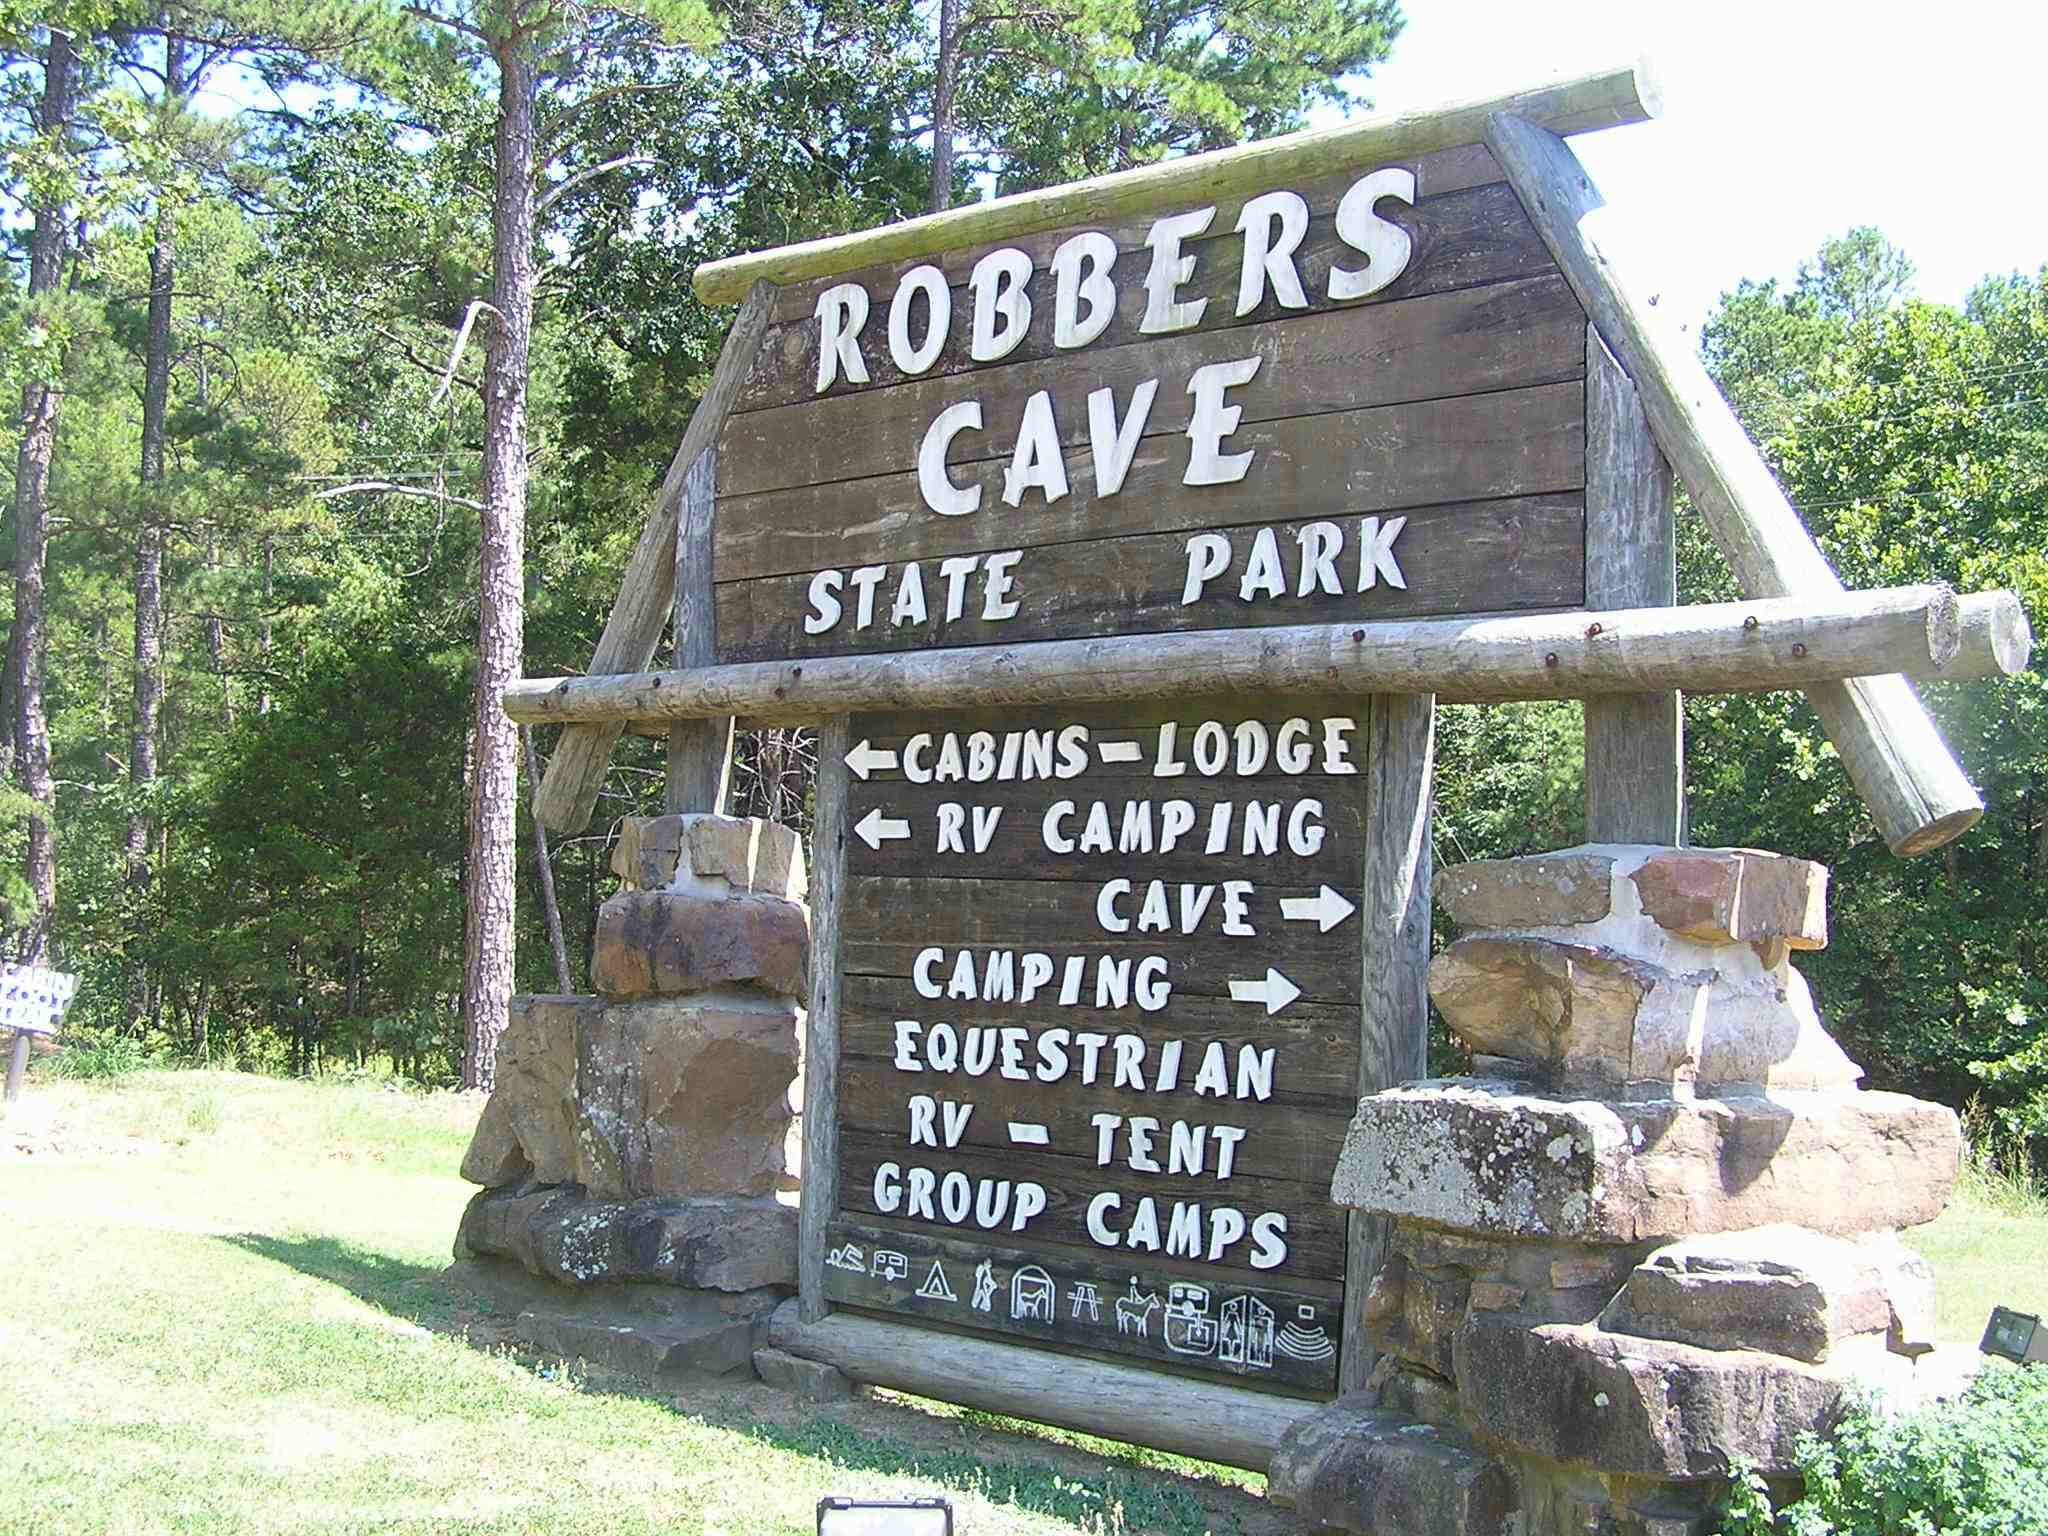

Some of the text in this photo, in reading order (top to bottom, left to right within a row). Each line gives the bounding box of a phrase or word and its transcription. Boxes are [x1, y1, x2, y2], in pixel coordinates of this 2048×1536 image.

[814, 166, 1416, 393] ROBBERS
[917, 355, 1262, 516] CAVE
[804, 516, 1407, 634] STATE PARK
[902, 724, 1089, 784] CABINS
[1153, 717, 1358, 777] LODGE
[936, 798, 1326, 858] RV CAMPING
[1095, 878, 1256, 937] CAVE
[912, 946, 1172, 1013] CAMPING
[893, 1020, 1276, 1101] EQUESTRIAN
[908, 1094, 974, 1148] RV
[1090, 1112, 1247, 1180] TENT
[873, 1162, 1288, 1270] GROUP CAMPS
